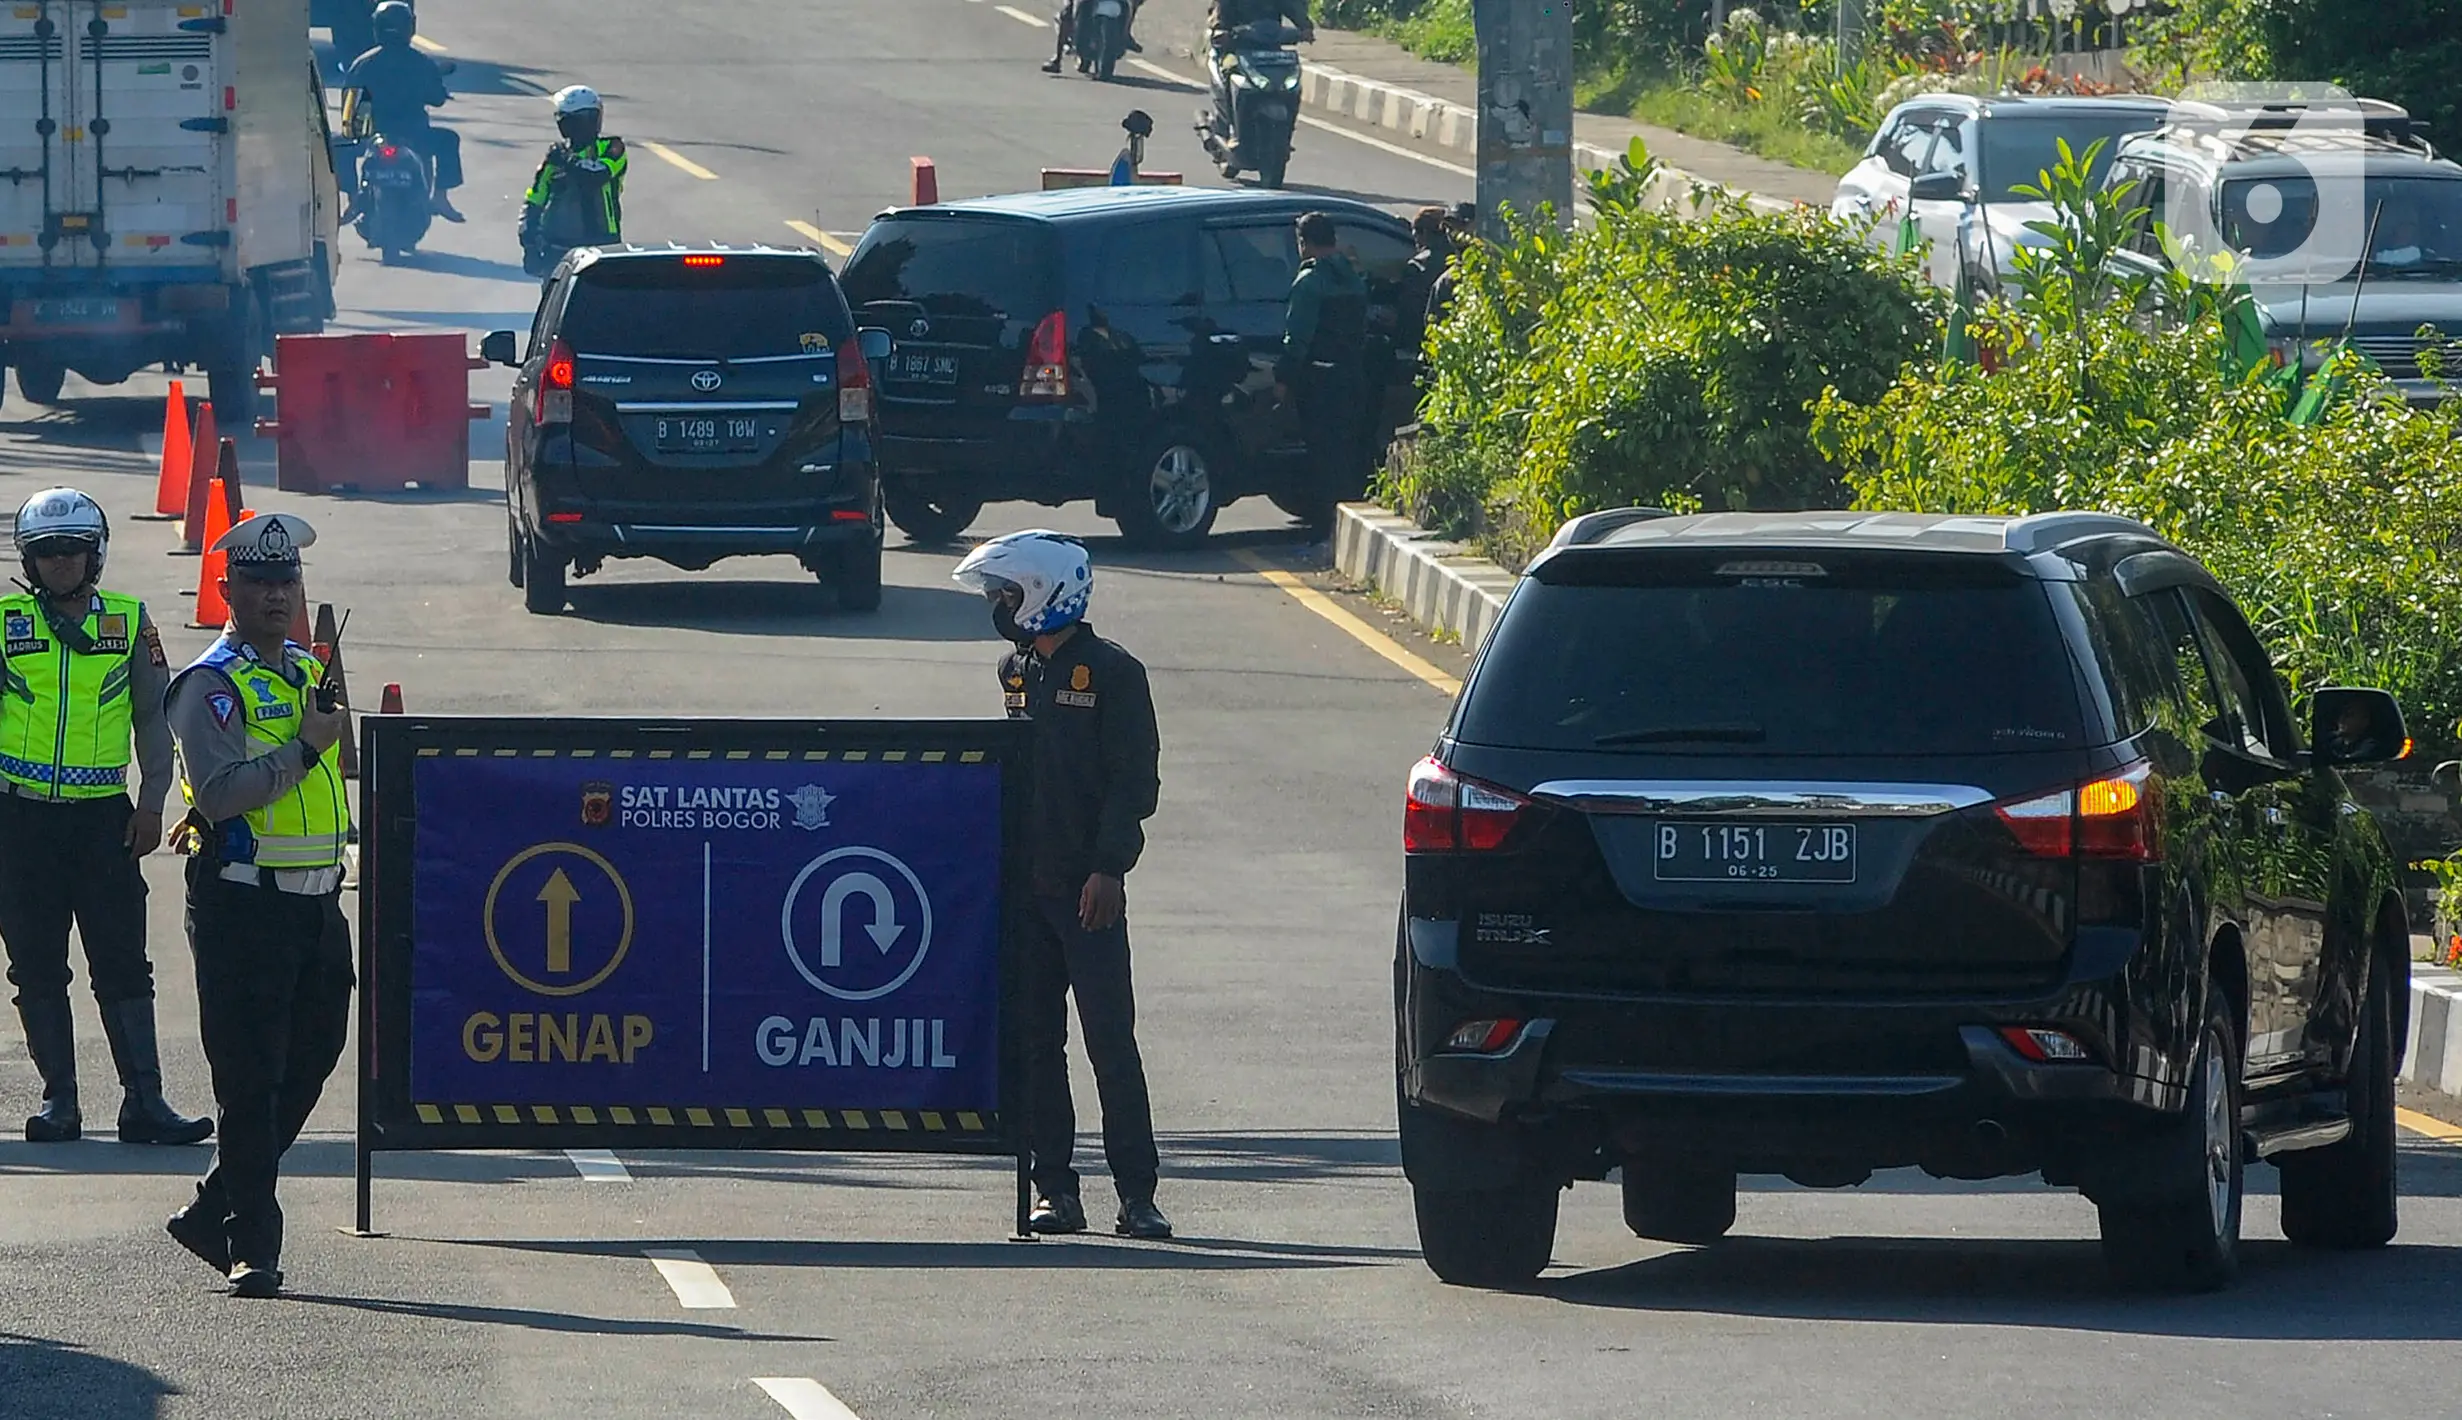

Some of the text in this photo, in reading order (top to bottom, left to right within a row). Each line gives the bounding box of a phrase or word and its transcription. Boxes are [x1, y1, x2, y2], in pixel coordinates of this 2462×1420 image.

[658, 421, 668, 439] B
[680, 420, 715, 438] 1489
[7, 640, 43, 653] BADRUS
[92, 639, 128, 650] OLISI
[620, 786, 780, 810] SAT LANTAS
[621, 810, 781, 829] POLRES BOGOR
[1660, 826, 1849, 861] B 1151 ZJB
[1479, 913, 1533, 926] ISUZU
[462, 1011, 653, 1065] GENAP
[756, 1015, 957, 1069] GANJIL
